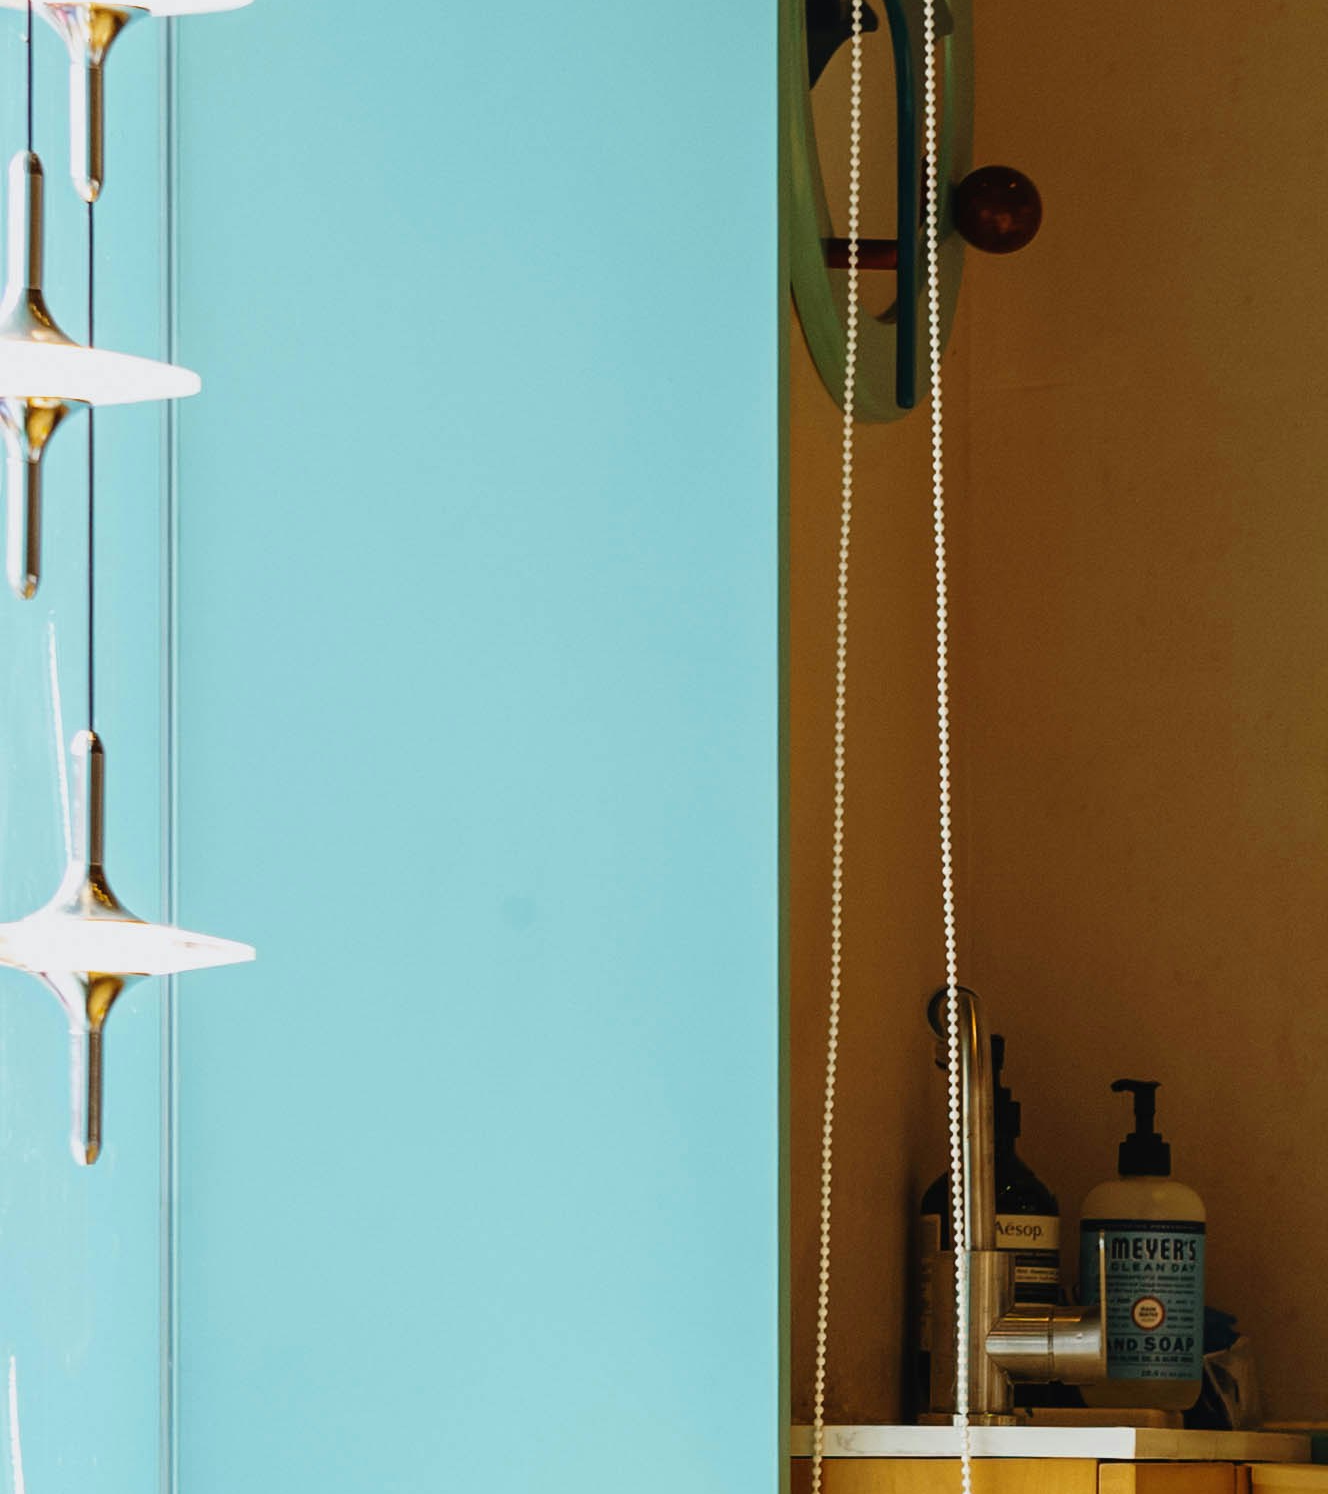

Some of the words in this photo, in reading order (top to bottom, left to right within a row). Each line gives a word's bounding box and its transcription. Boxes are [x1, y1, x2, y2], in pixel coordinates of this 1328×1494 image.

[1111, 1237, 1197, 1261] MEYER'S
[1111, 1263, 1165, 1273] CLEAN
[1171, 1263, 1196, 1274] DAY
[1144, 1336, 1195, 1353] SOAP
